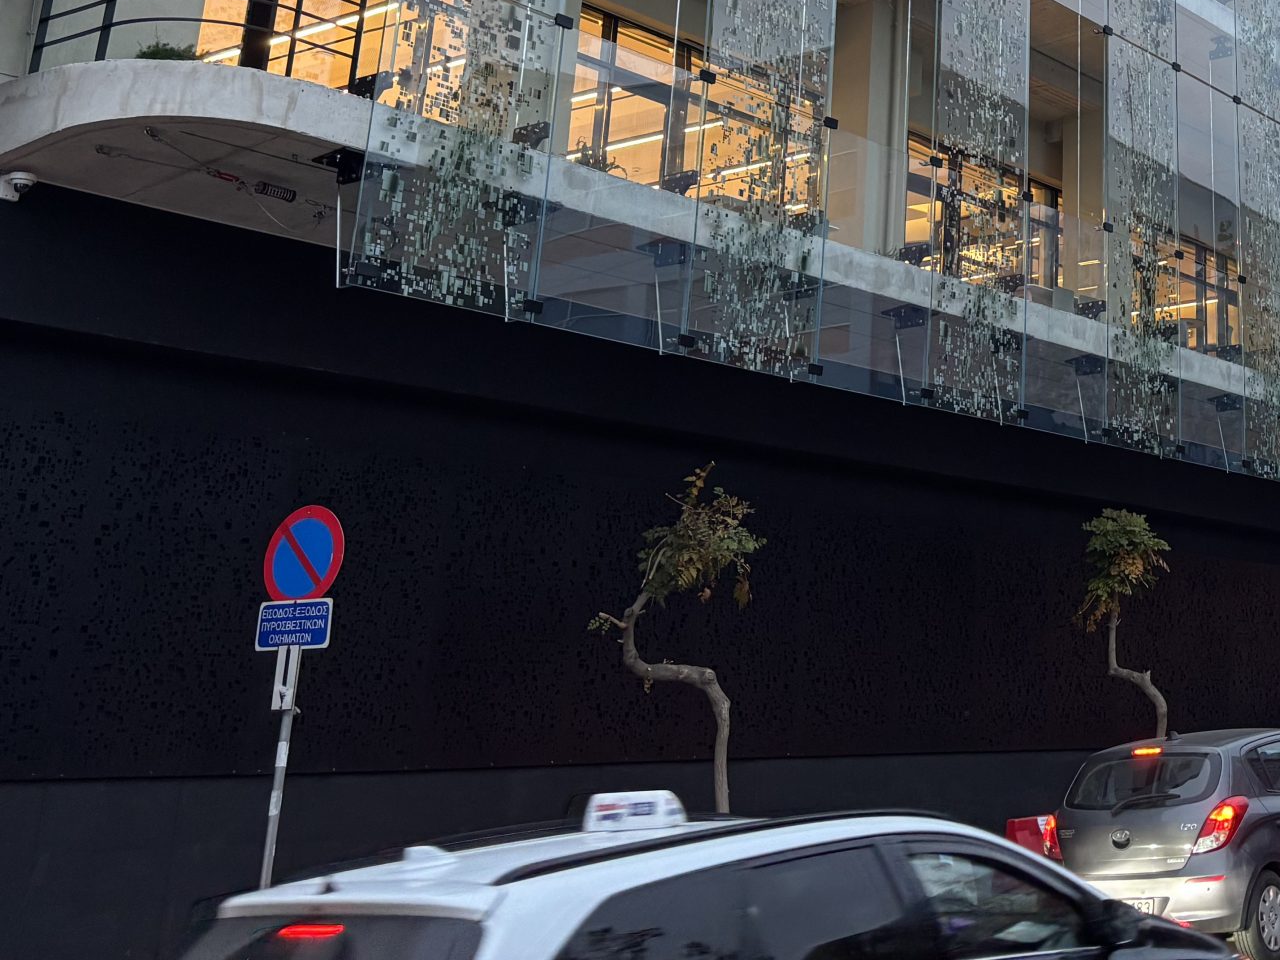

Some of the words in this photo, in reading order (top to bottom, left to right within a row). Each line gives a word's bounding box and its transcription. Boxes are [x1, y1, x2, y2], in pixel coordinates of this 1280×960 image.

[262, 605, 328, 619] ΕΙΣΟΔΟΣ-ΕΞΟΔΟΣ
[261, 619, 325, 632] ΠΥΡΟΣΒΕΣΤΙΚΩΝ
[268, 633, 312, 644] ΟΧΗΜΑΤΩΝ
